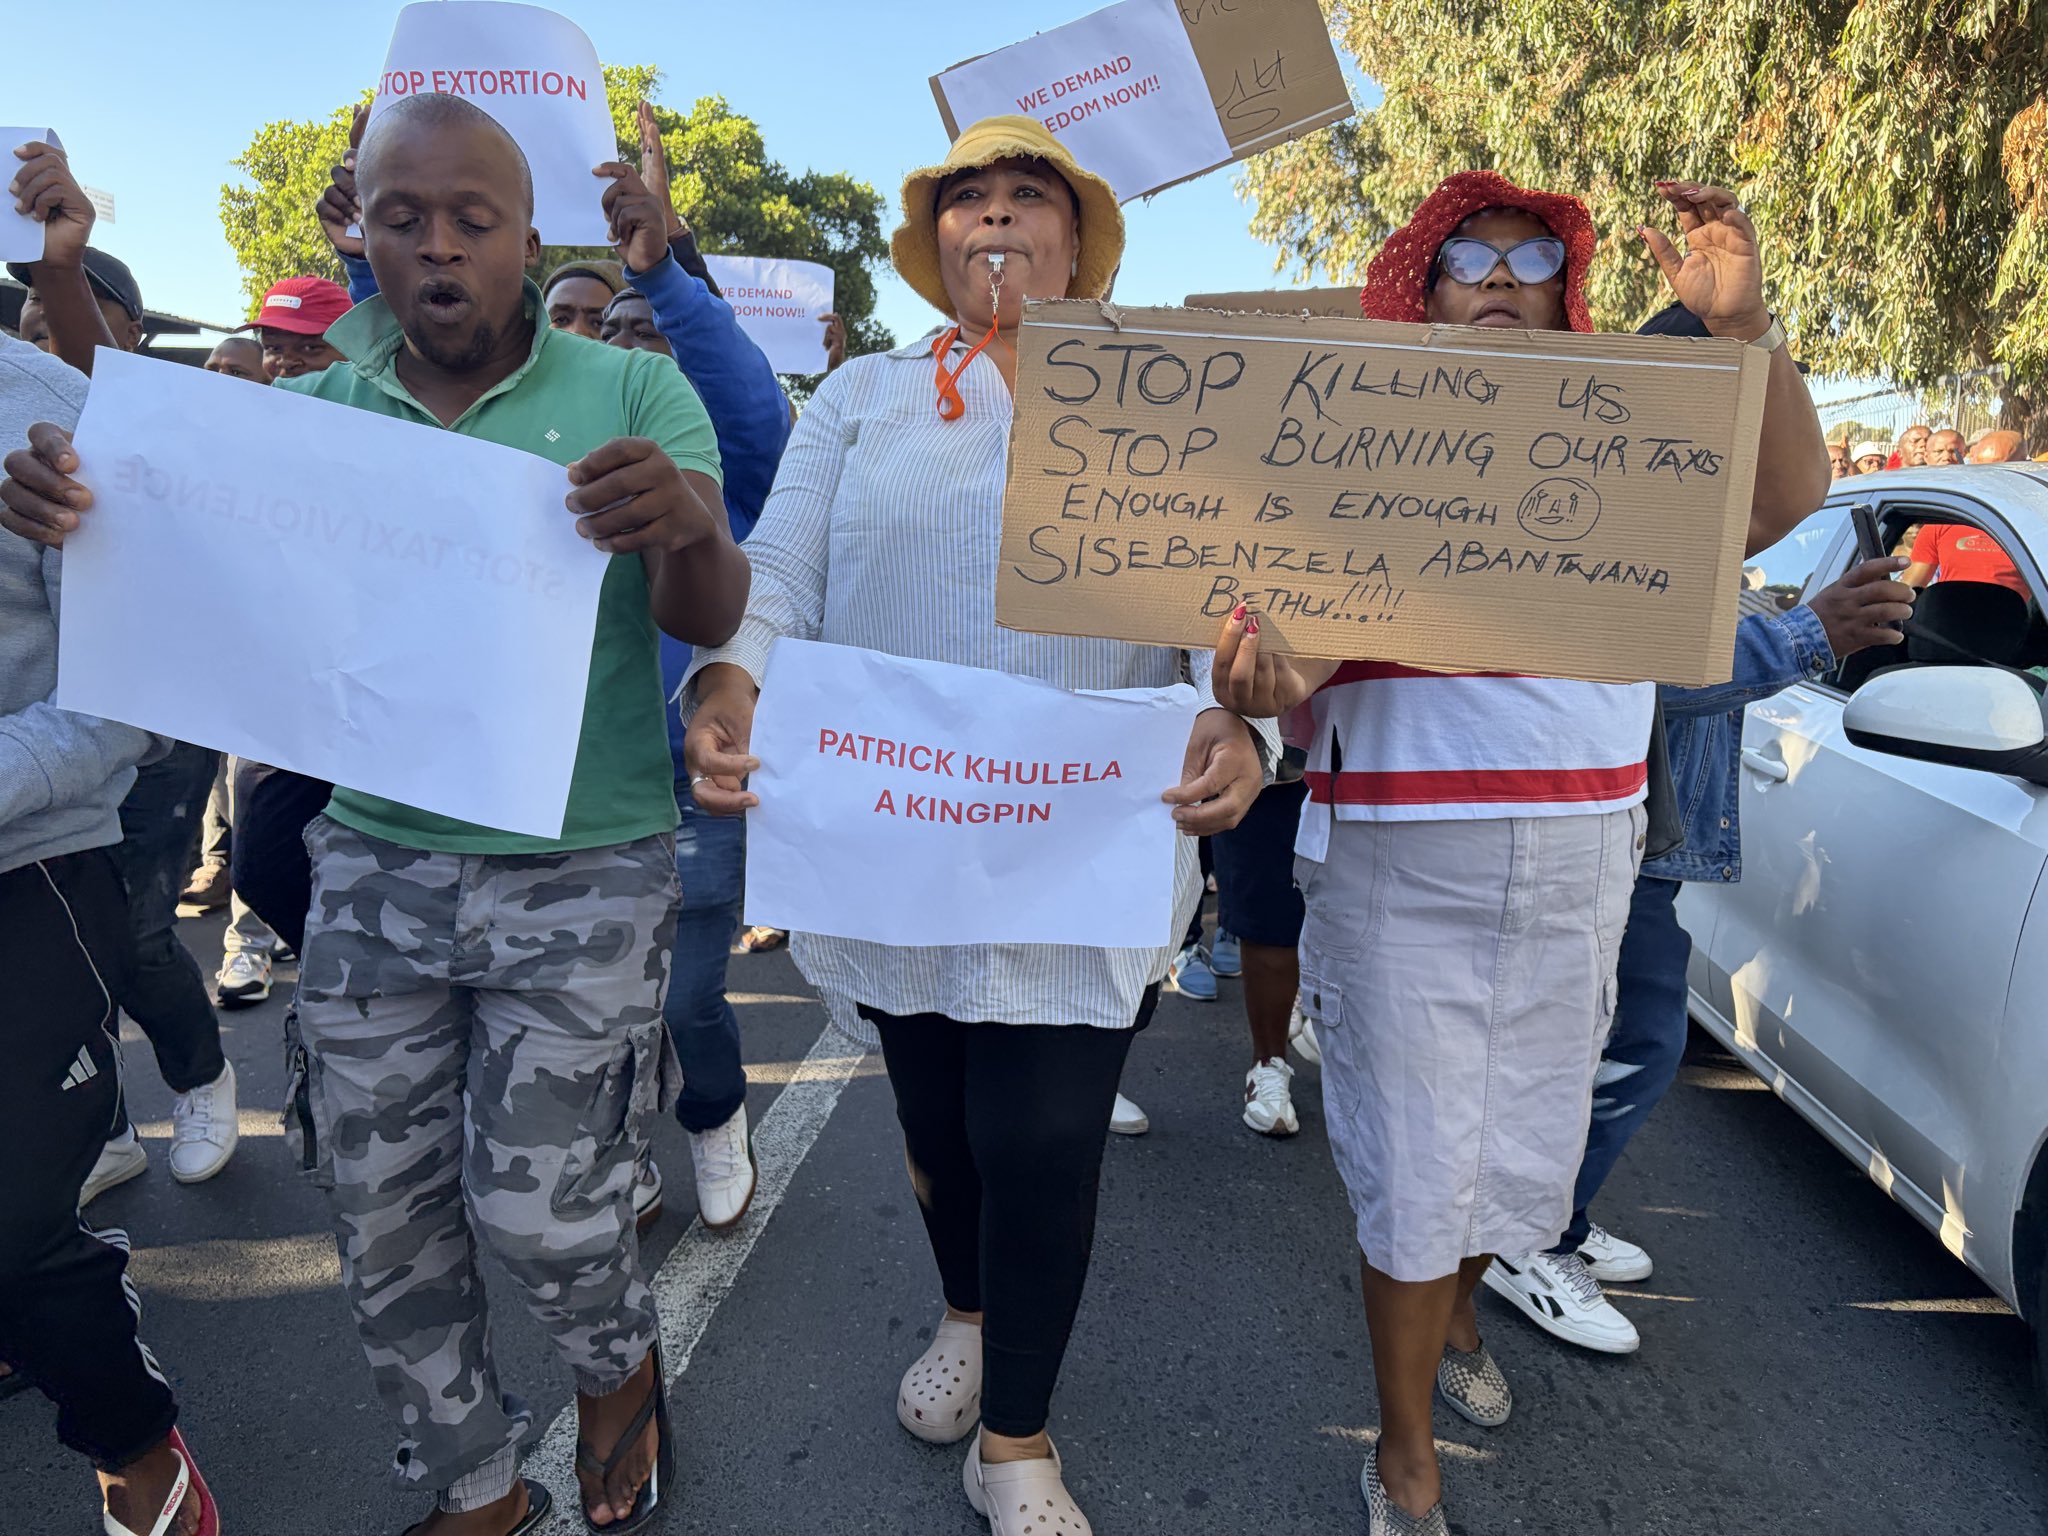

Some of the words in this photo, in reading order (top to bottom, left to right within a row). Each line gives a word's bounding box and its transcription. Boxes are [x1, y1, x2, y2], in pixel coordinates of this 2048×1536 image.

[431, 70, 587, 101] EXTORTION
[1016, 87, 1050, 113] WE
[1051, 55, 1133, 98] DEMAND
[1040, 98, 1102, 134] EDOM
[1102, 74, 1161, 110] NOW!!
[738, 287, 793, 299] DEMAND
[766, 307, 805, 318] NOW!!
[1043, 340, 1246, 415] STOP
[1279, 350, 1504, 427] KILLING
[1558, 374, 1632, 425] US
[1042, 415, 1218, 477] STOP
[1260, 416, 1496, 479] BURNING
[1529, 432, 1629, 479] OUR
[1640, 438, 1724, 484] TAXIS
[1061, 483, 1231, 523] ENOUGH
[1254, 492, 1294, 523] IS
[1328, 490, 1499, 528] ENOUGH
[1014, 526, 1392, 588] SISEBENZELA
[818, 728, 957, 777] PATRICK
[964, 754, 1123, 785] KHULELA
[874, 789, 897, 816] A
[905, 793, 1052, 825] KINGPIN
